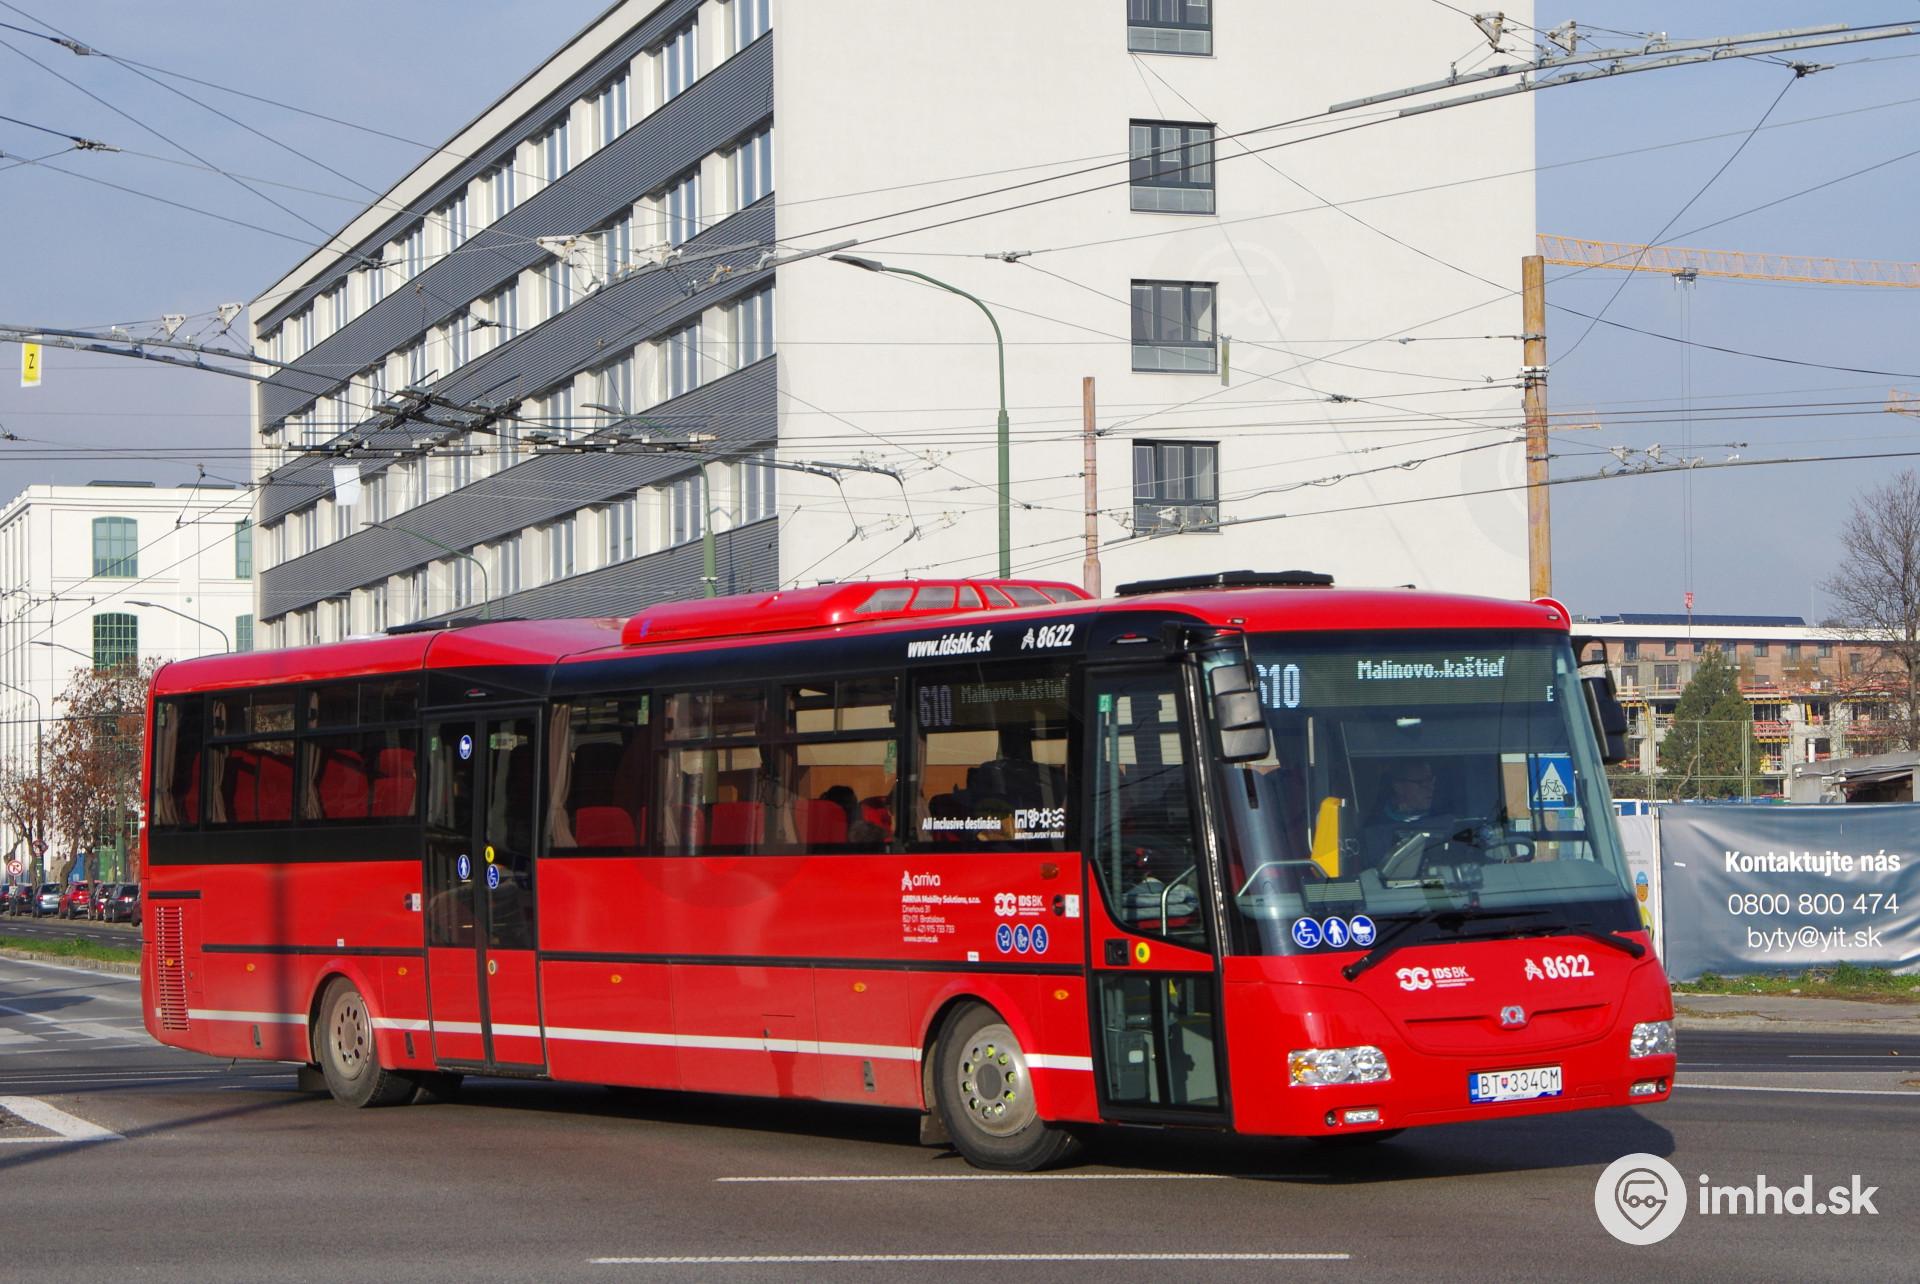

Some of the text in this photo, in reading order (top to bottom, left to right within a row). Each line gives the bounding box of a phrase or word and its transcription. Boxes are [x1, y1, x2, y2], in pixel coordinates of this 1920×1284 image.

[907, 629, 994, 658] www.idsbk.sk
[1036, 623, 1076, 649] 8622
[919, 685, 952, 727] 610
[922, 816, 933, 830] All
[933, 816, 964, 830] inclusive
[1725, 849, 1901, 877] Kontaktujte nás
[1727, 893, 1900, 916] 0800 800 474
[1747, 925, 1883, 953] byty@yit.sk
[1542, 954, 1595, 979] 8622
